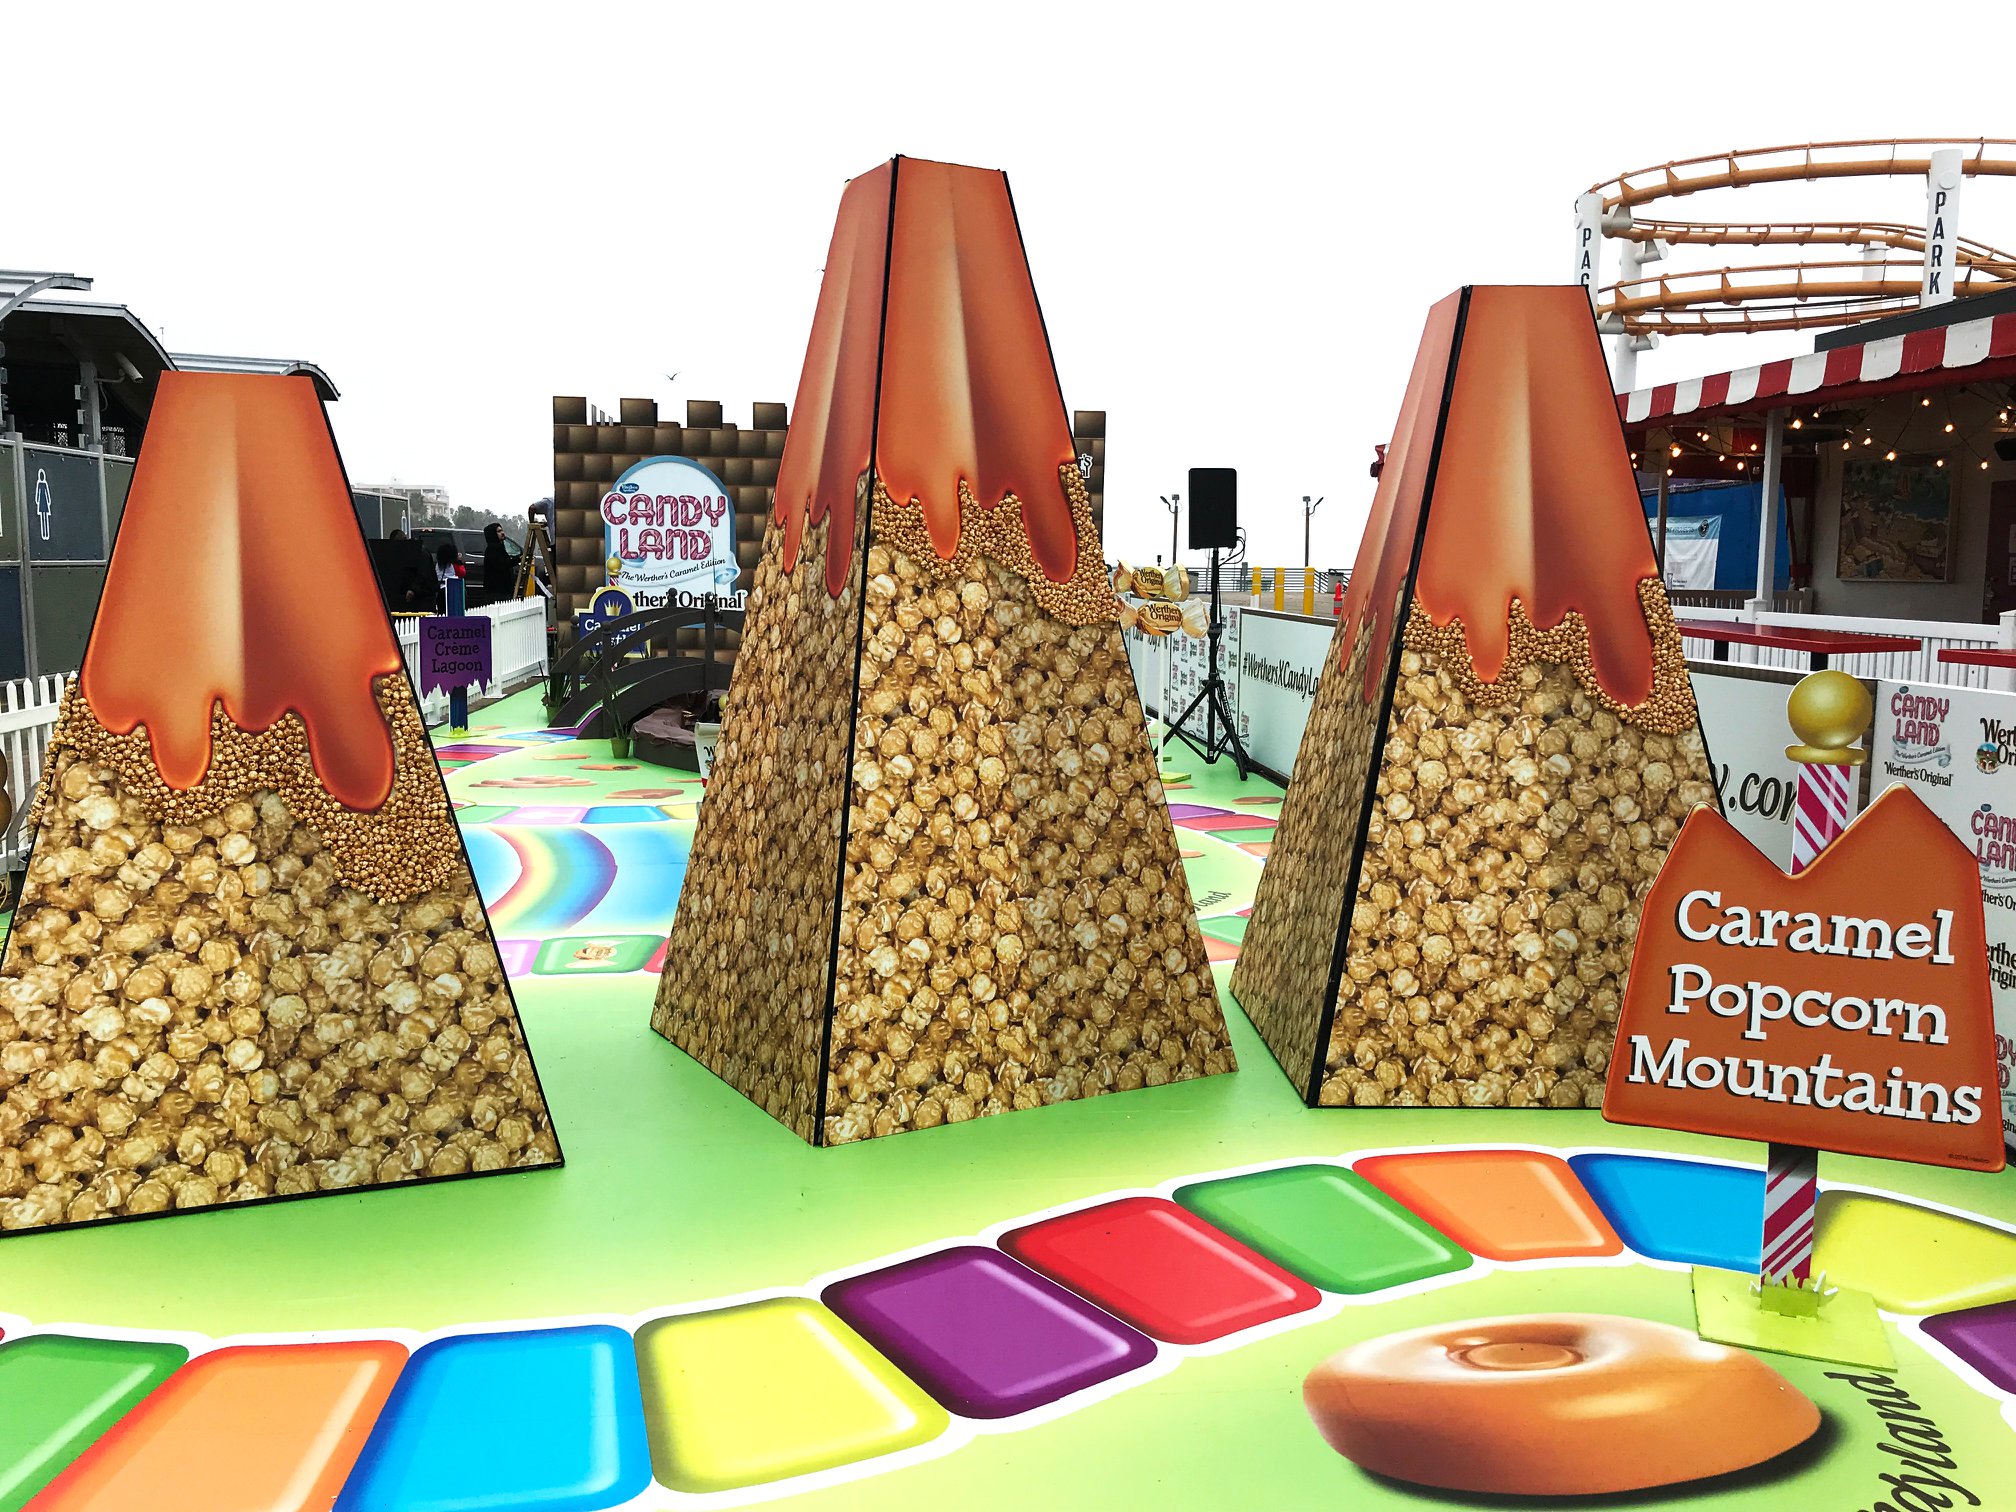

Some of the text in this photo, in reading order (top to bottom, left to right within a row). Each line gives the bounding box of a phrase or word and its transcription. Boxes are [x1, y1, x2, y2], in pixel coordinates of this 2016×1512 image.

[1929, 191, 1947, 295] PARK
[603, 492, 726, 527] CANDY
[619, 528, 712, 560] LAND
[621, 558, 726, 582] The Werther's Caramel Edition
[678, 590, 743, 609] Oriinal
[427, 624, 487, 640] Caramel
[434, 641, 480, 657] Crème
[431, 658, 483, 675] Lagoon
[1891, 692, 1950, 723] CANDY
[1895, 718, 1941, 747] LAND
[1884, 761, 1953, 787] Werther's Original
[1676, 889, 1955, 965] Caramel
[1666, 963, 1950, 1045] Popcorn
[1627, 1034, 1983, 1125] Mountains
